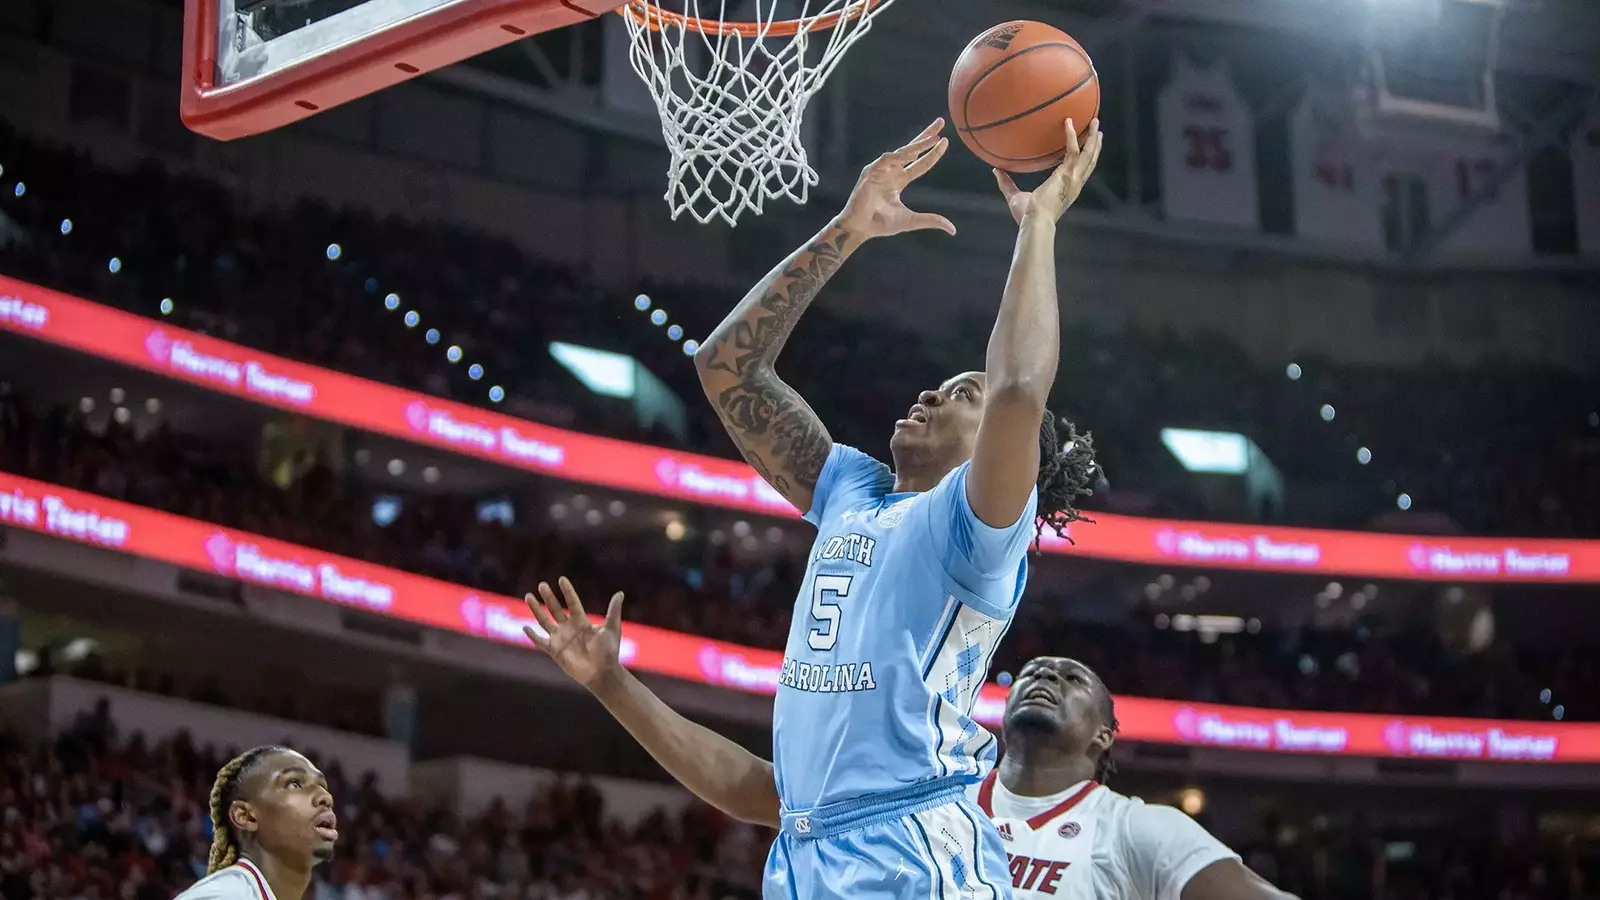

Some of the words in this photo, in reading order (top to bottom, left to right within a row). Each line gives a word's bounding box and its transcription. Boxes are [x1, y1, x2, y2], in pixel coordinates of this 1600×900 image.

[807, 574, 853, 651] 5
[779, 658, 876, 692] CAROLINA
[1007, 852, 1071, 895] ATE
